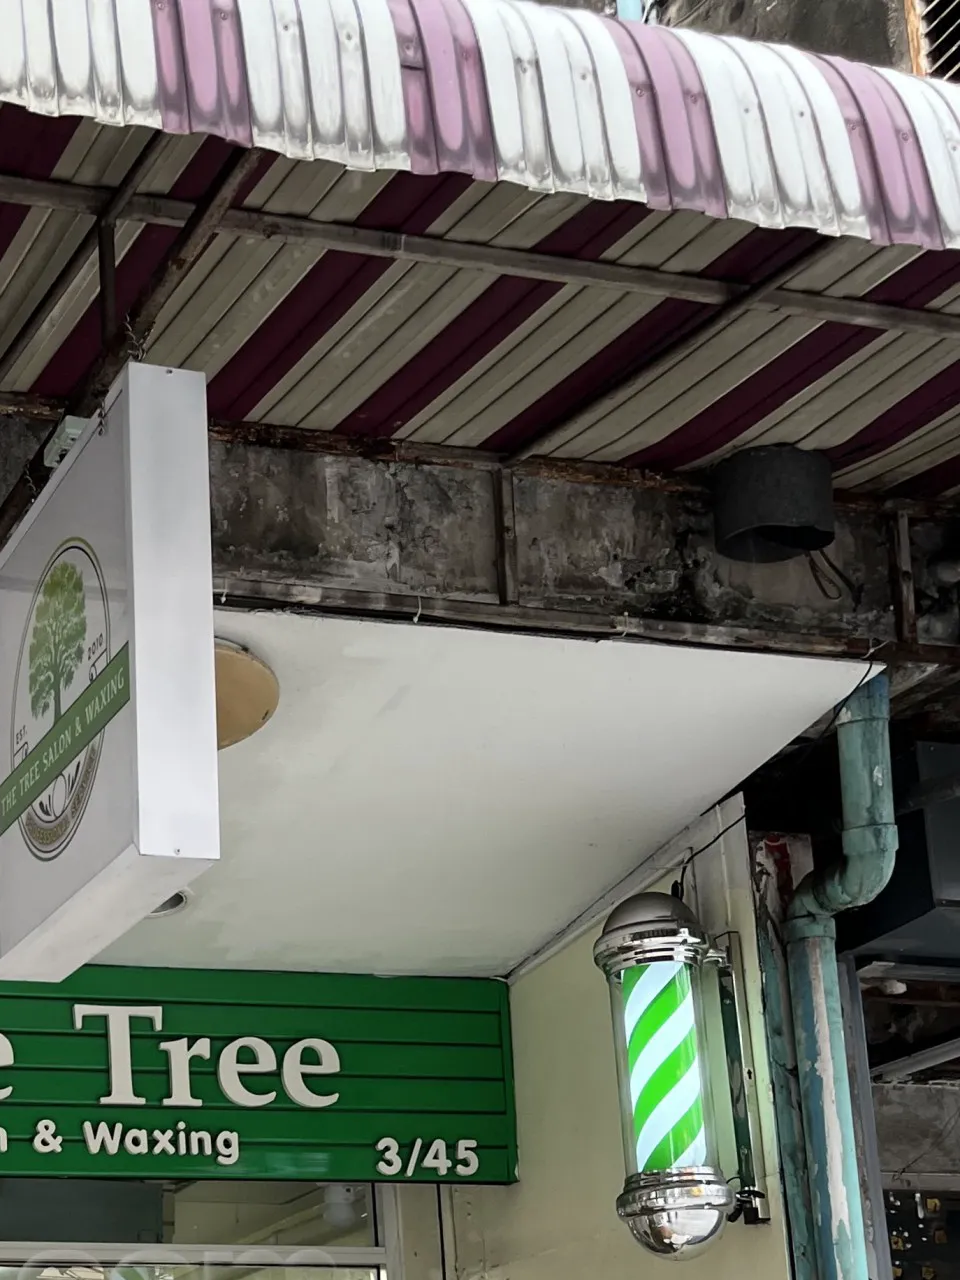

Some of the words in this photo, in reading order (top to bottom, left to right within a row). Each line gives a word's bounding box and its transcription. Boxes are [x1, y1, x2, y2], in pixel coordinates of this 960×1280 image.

[88, 633, 104, 660] 2010
[1, 788, 17, 816] THE
[20, 763, 41, 795] TREE
[42, 725, 72, 772] SALON
[75, 716, 82, 737] &
[84, 667, 125, 725] WAXING
[16, 725, 28, 745] EST.
[73, 1004, 340, 1108] Tree
[33, 1119, 63, 1153] &
[83, 1120, 239, 1165] Waxing
[375, 1137, 479, 1176] 3/45
